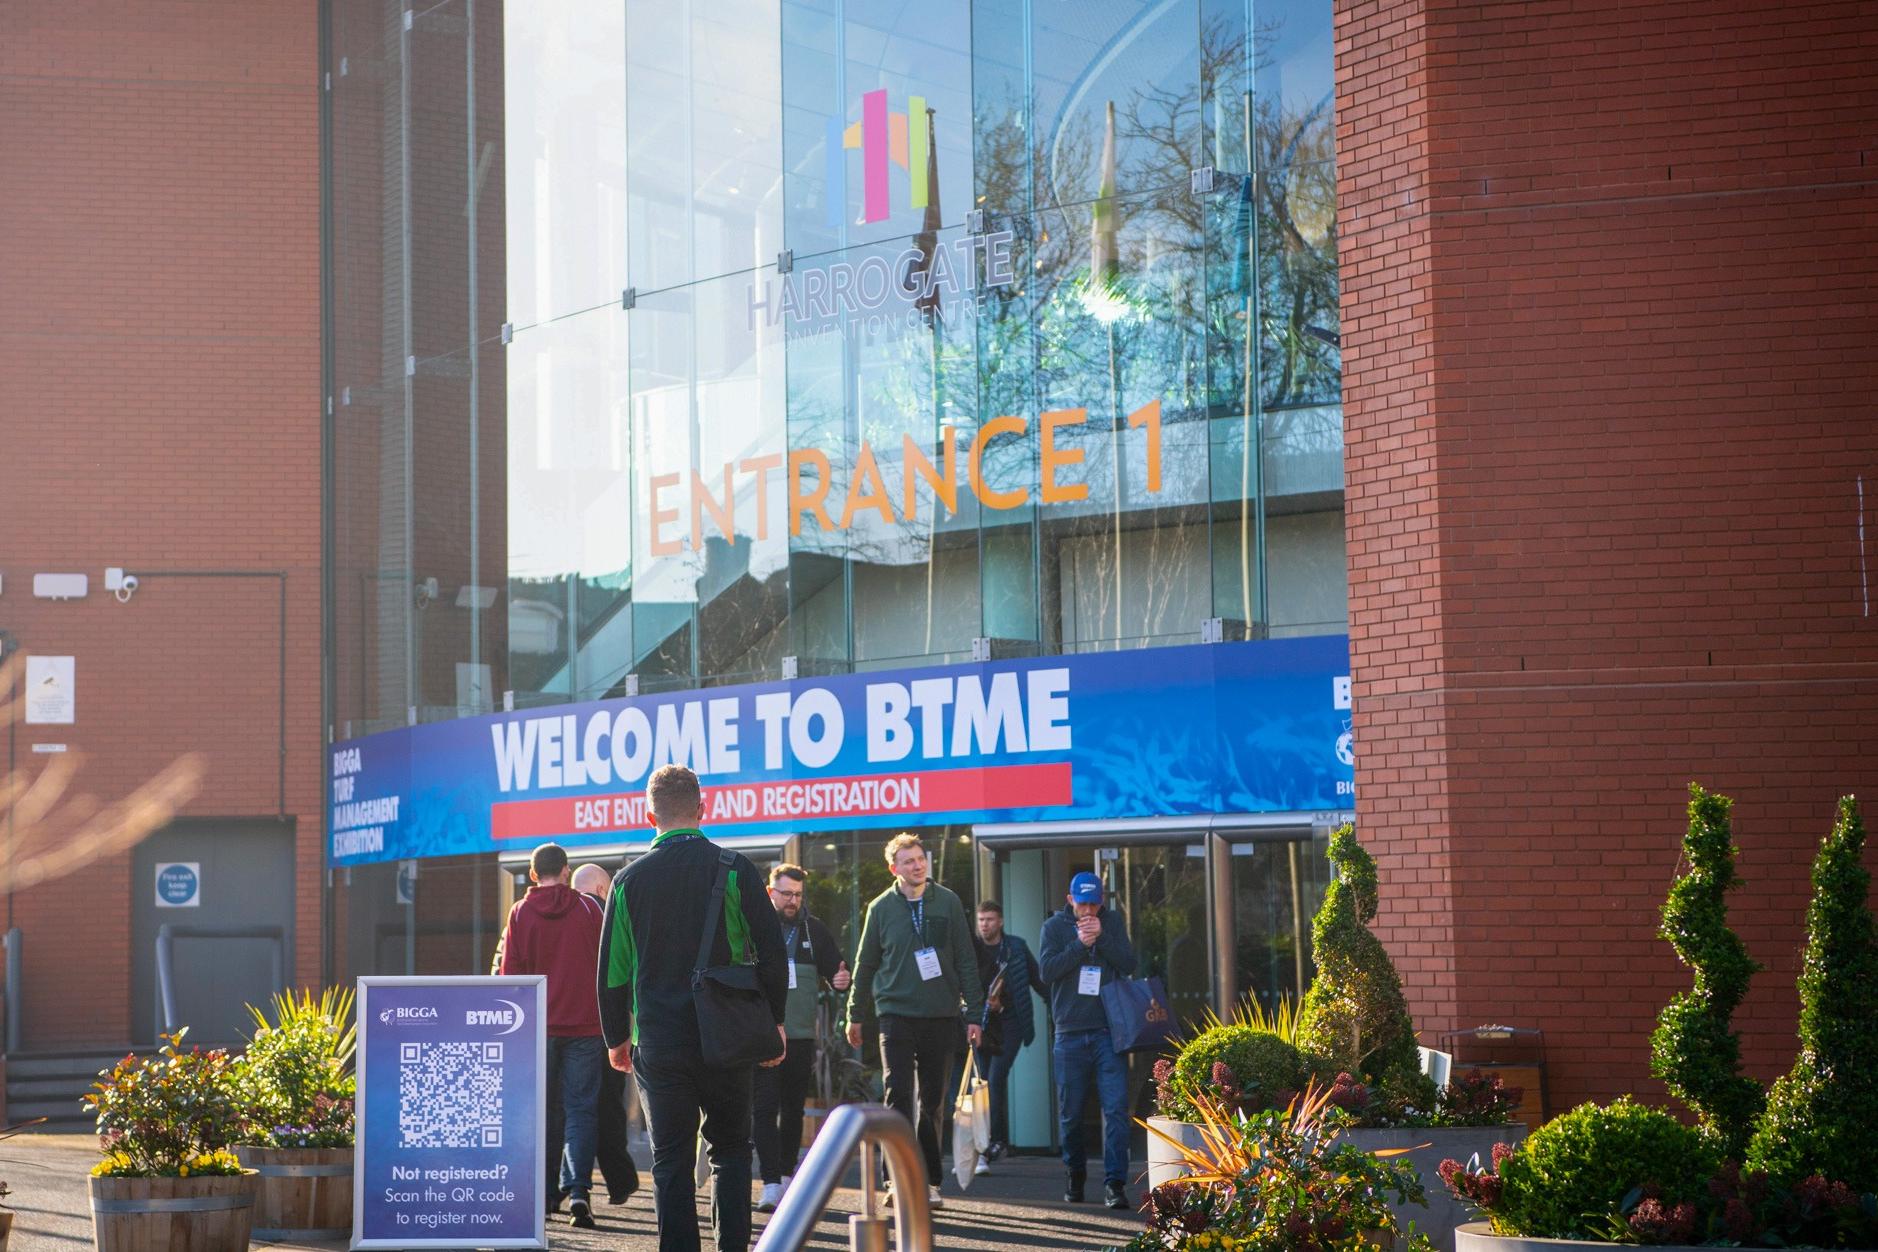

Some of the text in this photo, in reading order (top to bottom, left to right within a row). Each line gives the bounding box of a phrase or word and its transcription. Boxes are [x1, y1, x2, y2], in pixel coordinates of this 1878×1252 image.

[747, 230, 1014, 331] HARROGATE
[906, 295, 986, 329] CENTRE
[650, 399, 1162, 557] ENTRANCE 1
[491, 667, 1072, 792] WELCOME TO BTME
[334, 748, 361, 776] BIGGA
[334, 776, 354, 803] TURF
[575, 799, 610, 829] EAST
[712, 787, 757, 819] AND
[763, 777, 921, 815] REGISTRATION
[334, 796, 399, 830] MANAGEMENT
[334, 826, 383, 857] EXHIBITION
[397, 1007, 438, 1018] BIGGA
[466, 1010, 513, 1025] BTME
[392, 1164, 509, 1184] Not registered?
[385, 1185, 515, 1202] Scan the QR code
[396, 1211, 503, 1228] to register now.
